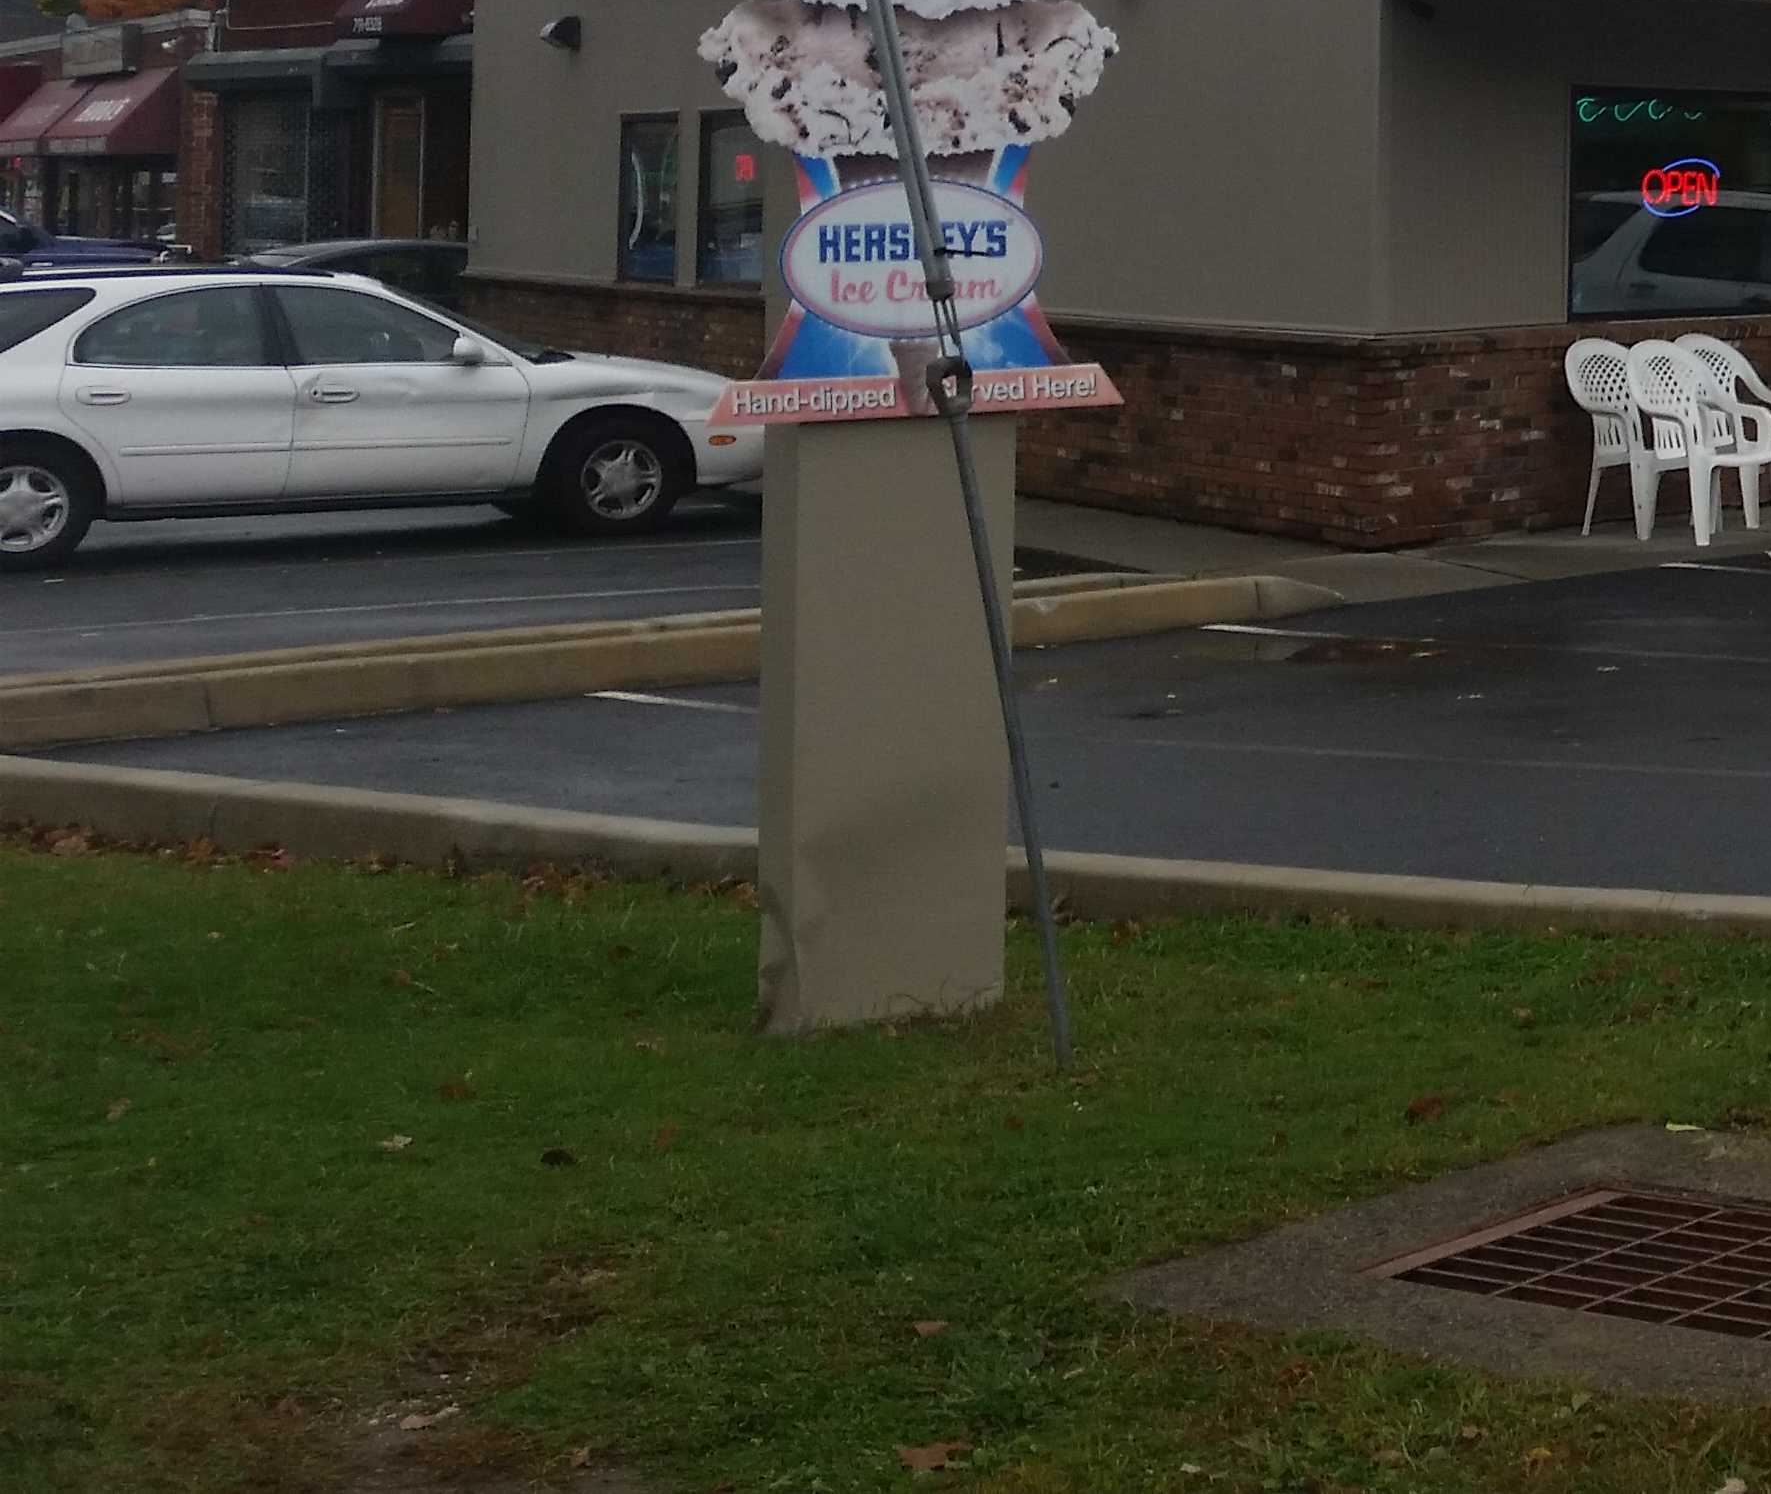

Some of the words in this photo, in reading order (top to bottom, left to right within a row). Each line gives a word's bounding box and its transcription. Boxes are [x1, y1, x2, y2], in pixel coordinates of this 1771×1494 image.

[1642, 168, 1718, 207] OPEN
[818, 220, 1007, 264] HERSEY'S
[830, 268, 877, 304] Ice
[885, 268, 1001, 303] Crm
[731, 384, 896, 416] Hand-dipped
[1032, 372, 1097, 401] Here!
